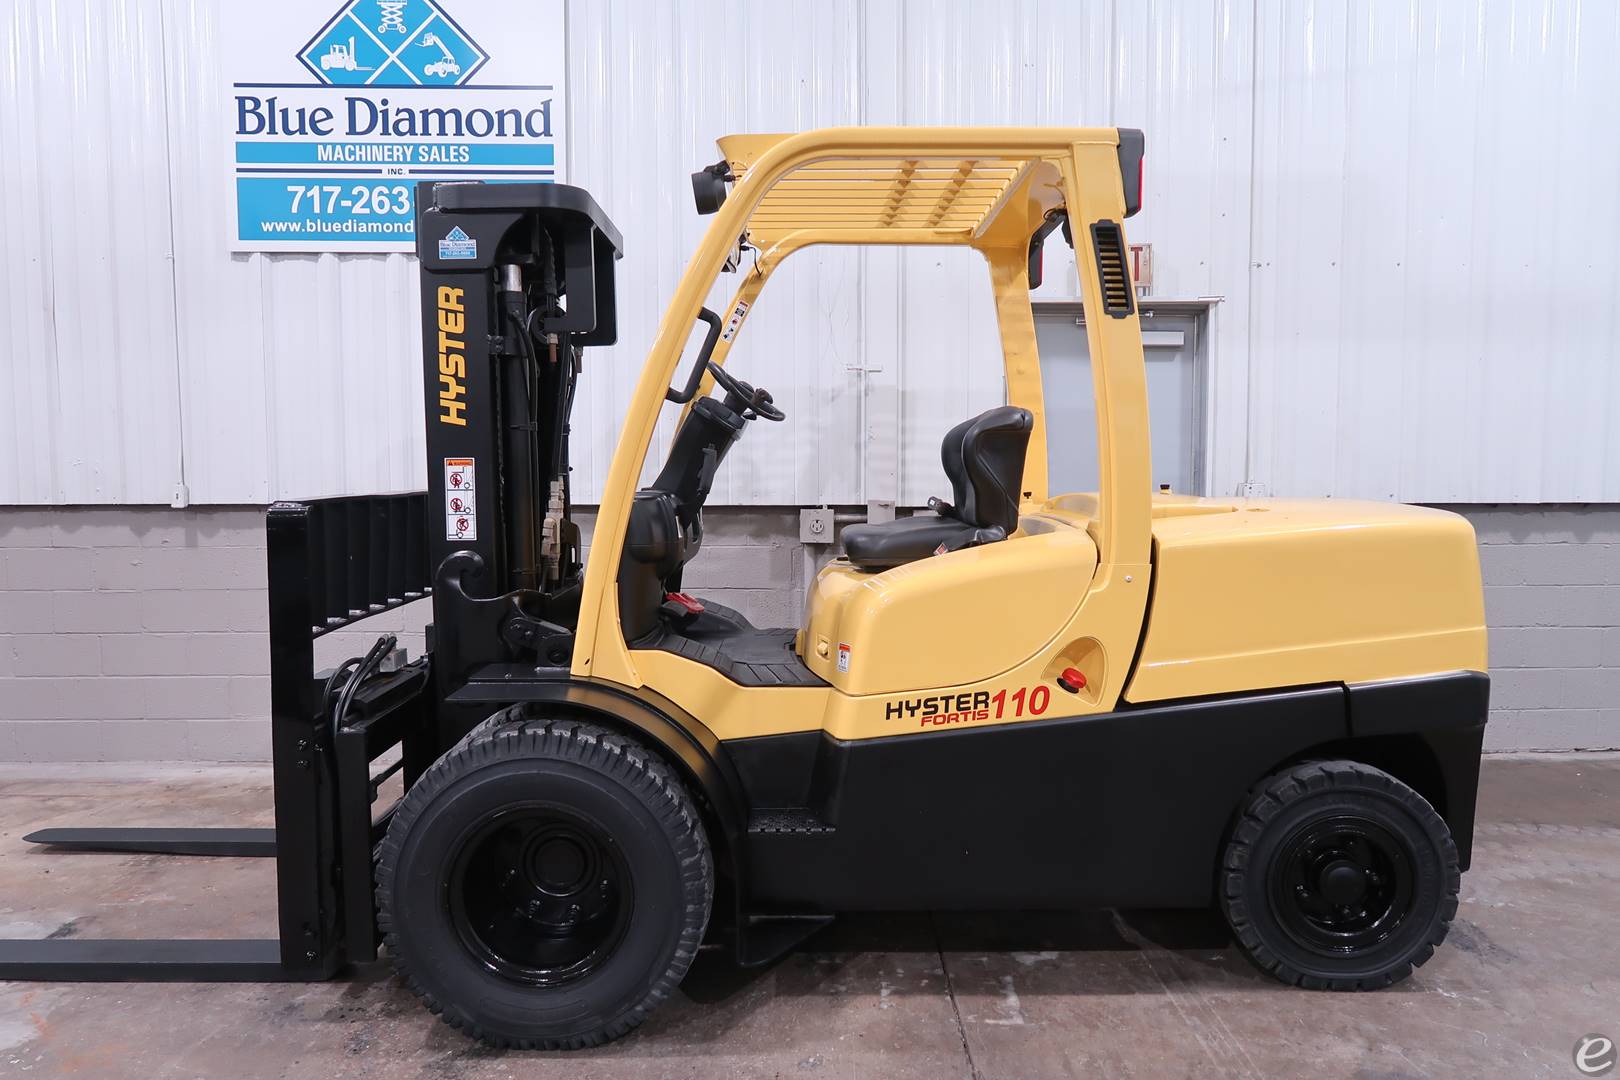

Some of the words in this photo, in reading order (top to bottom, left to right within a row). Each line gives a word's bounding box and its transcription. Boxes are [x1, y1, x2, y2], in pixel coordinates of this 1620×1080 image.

[235, 96, 334, 136] Blue
[345, 97, 553, 138] Diamond
[317, 144, 414, 162] MACHINERY
[418, 145, 470, 163] SALES
[287, 185, 414, 214] 717-263
[437, 286, 467, 426] HYSTER
[885, 691, 990, 720] HYSTER
[991, 685, 1051, 718] 110
[920, 709, 989, 727] FORTIS
